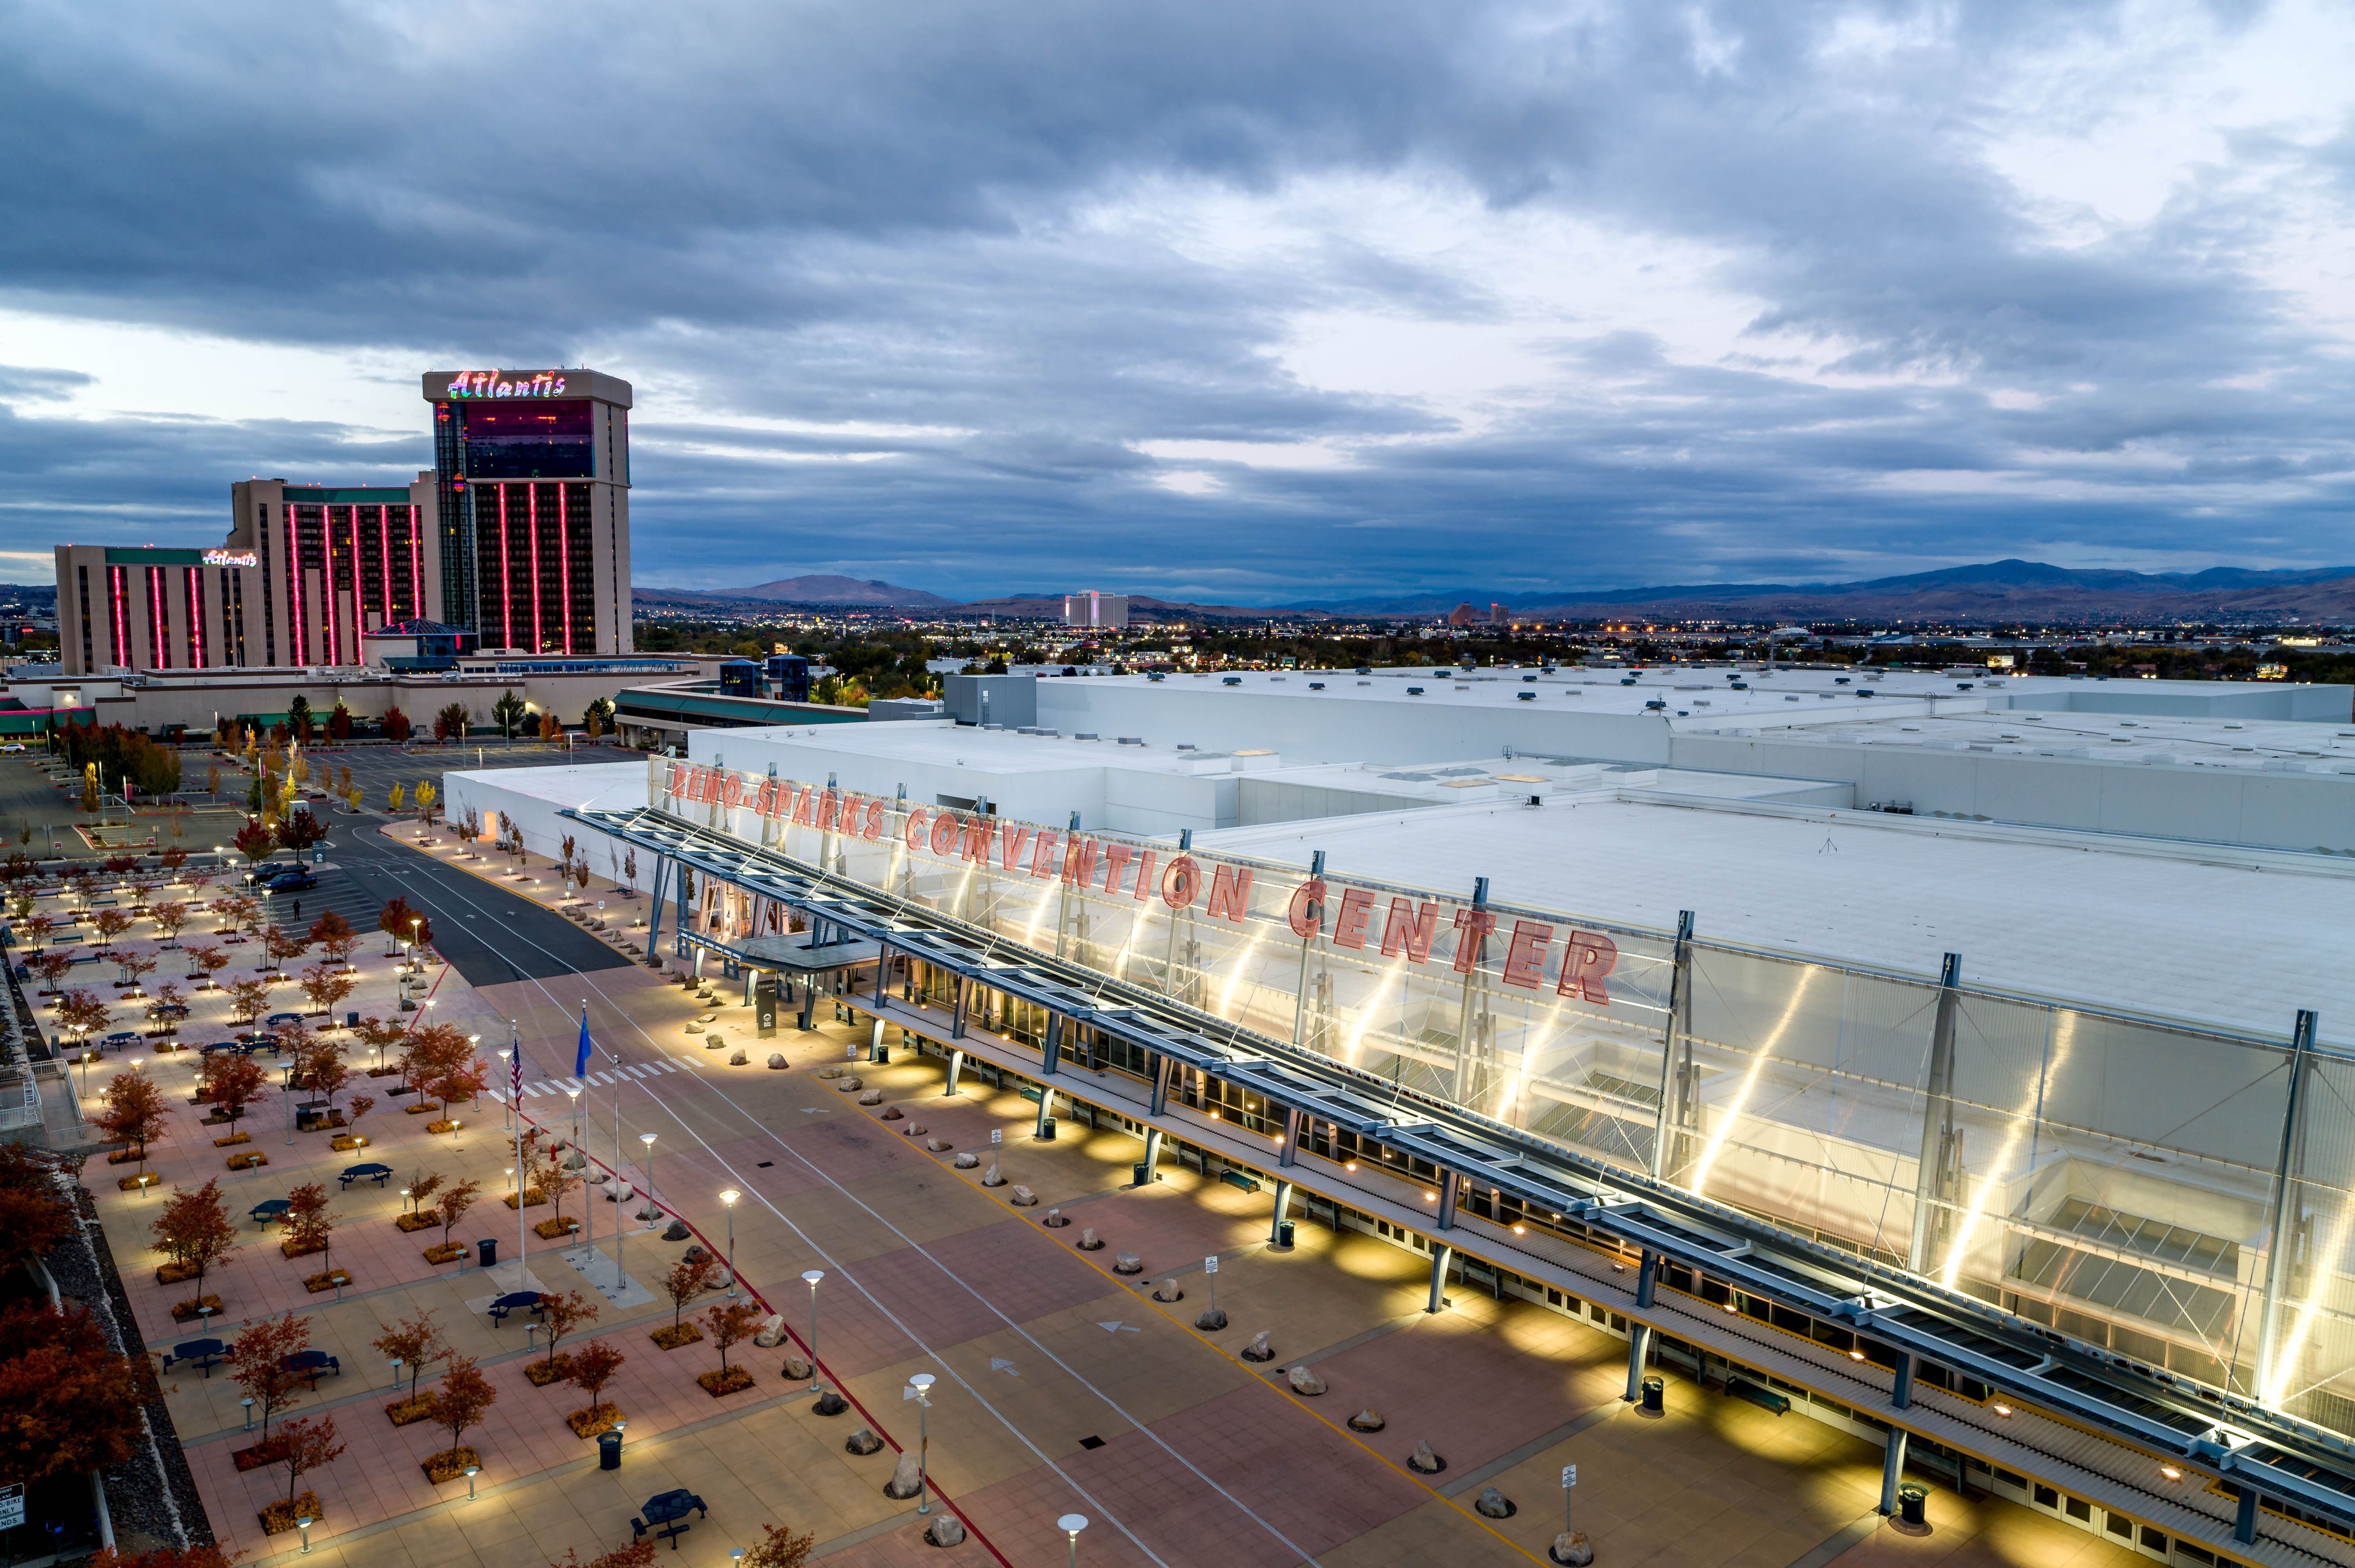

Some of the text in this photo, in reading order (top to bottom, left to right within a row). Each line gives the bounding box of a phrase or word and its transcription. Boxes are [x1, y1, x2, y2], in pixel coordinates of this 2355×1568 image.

[448, 368, 565, 399] Atlantis
[202, 550, 257, 567] Atlantis
[671, 765, 1618, 1007] RENO-SPARKS CONVENTION CENTER
[0, 1497, 22, 1508] S/BIKE
[0, 1518, 17, 1527] NDS
